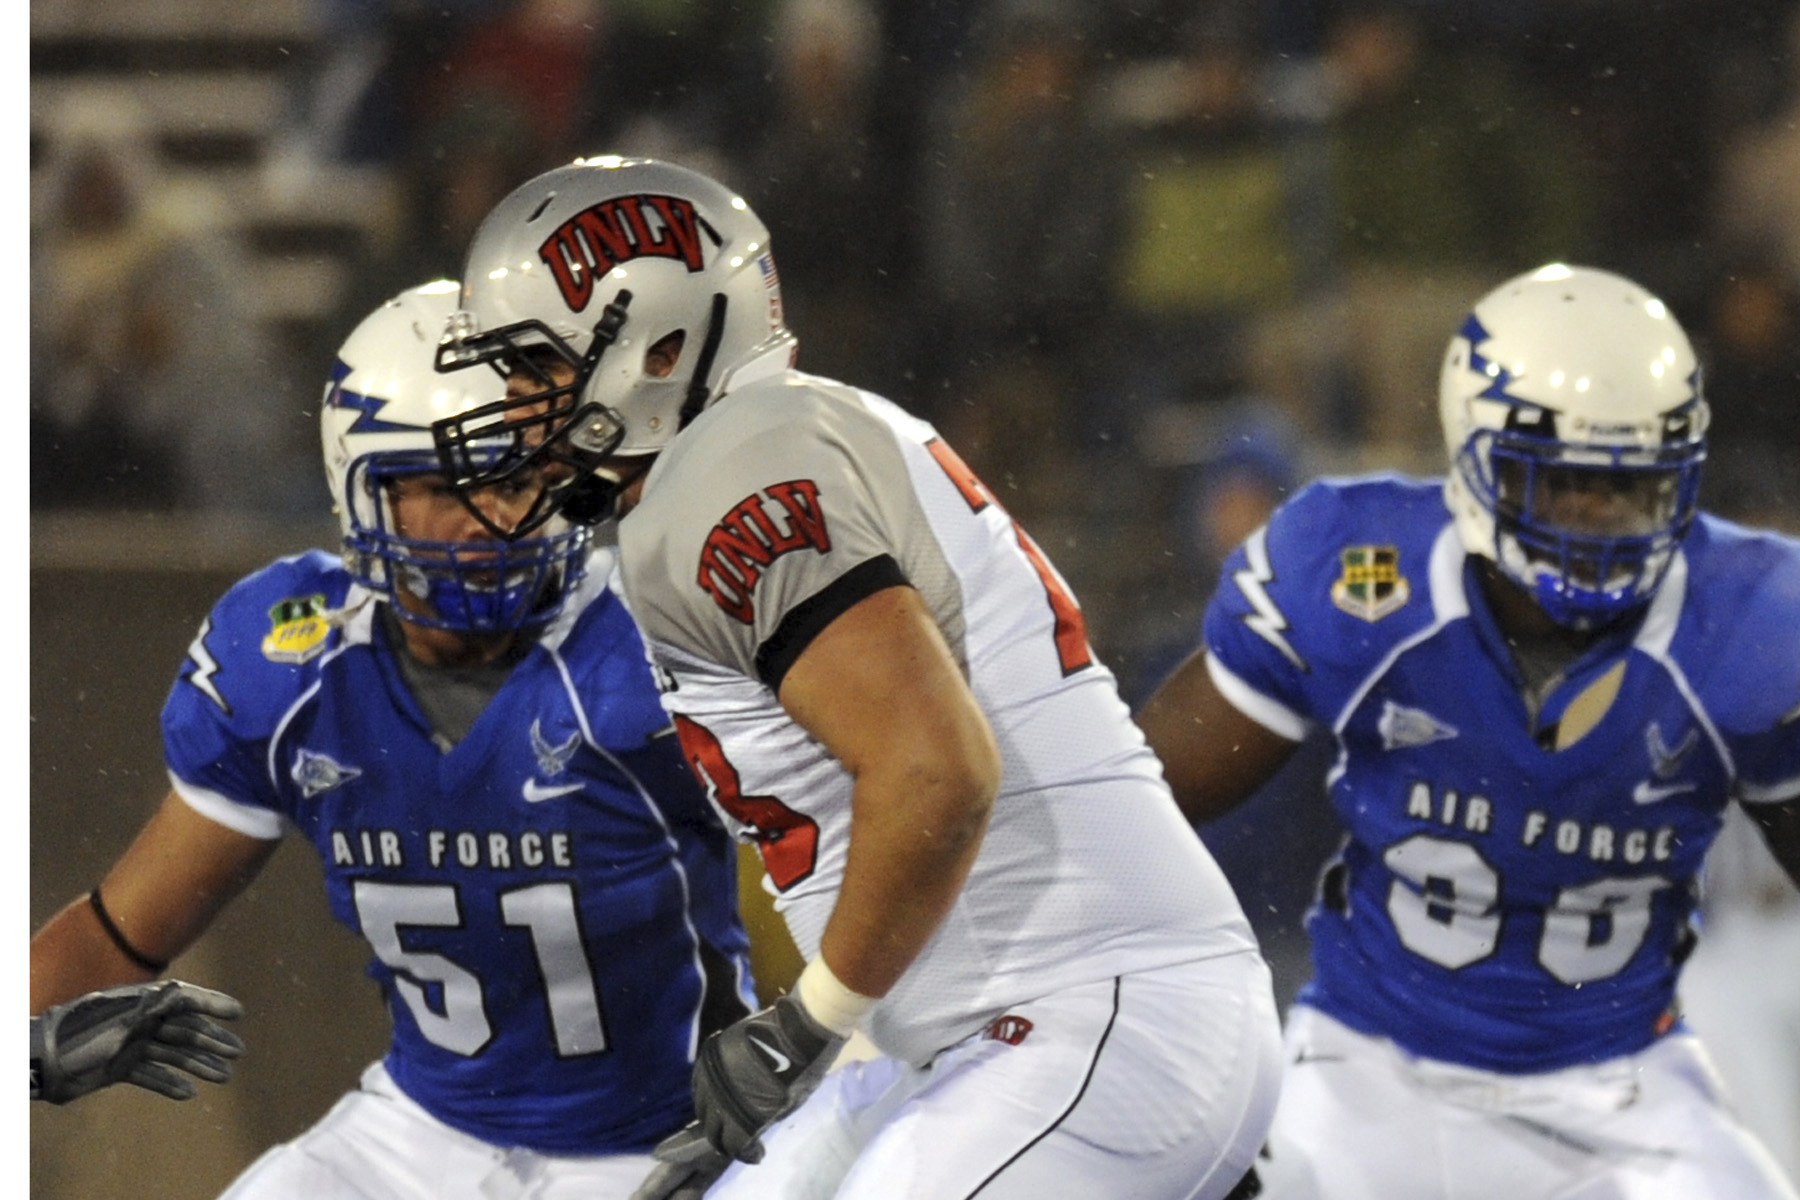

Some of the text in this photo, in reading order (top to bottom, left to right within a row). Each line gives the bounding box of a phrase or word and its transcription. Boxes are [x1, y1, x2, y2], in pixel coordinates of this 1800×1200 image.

[538, 193, 704, 314] UNLV
[697, 479, 832, 625] UNLV
[332, 830, 572, 868] AIR FORCE
[1408, 782, 1674, 864] AIR FORCE
[352, 878, 608, 1060] 51
